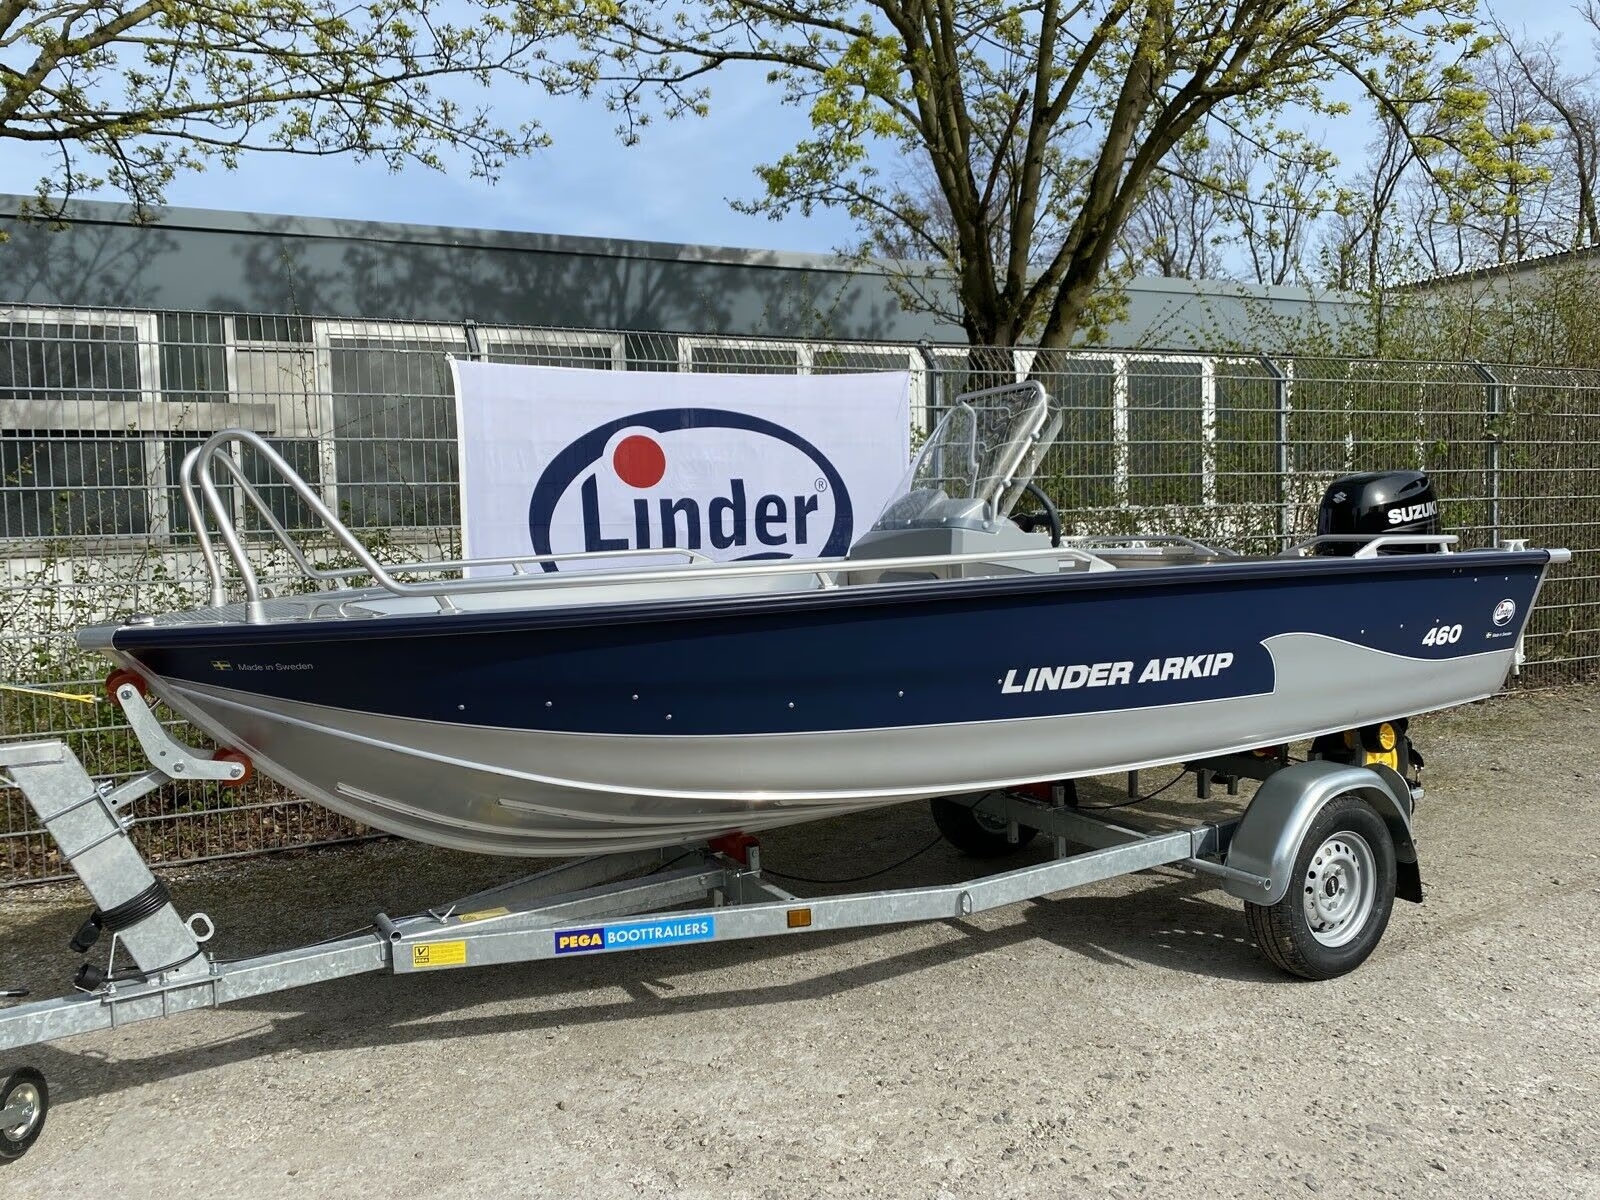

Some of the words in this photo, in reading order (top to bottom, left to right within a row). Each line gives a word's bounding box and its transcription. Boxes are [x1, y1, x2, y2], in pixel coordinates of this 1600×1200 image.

[581, 472, 818, 552] Linder
[1387, 501, 1438, 525] SUZUKI
[1421, 624, 1463, 647] 460
[237, 663, 263, 671] Made
[266, 663, 274, 671] in
[275, 662, 314, 671] Sweden
[1001, 661, 1135, 694] LINDER
[1138, 652, 1234, 684] ARKIP
[559, 933, 602, 949] PEGA
[607, 921, 709, 944] BOOTTRAILERS
